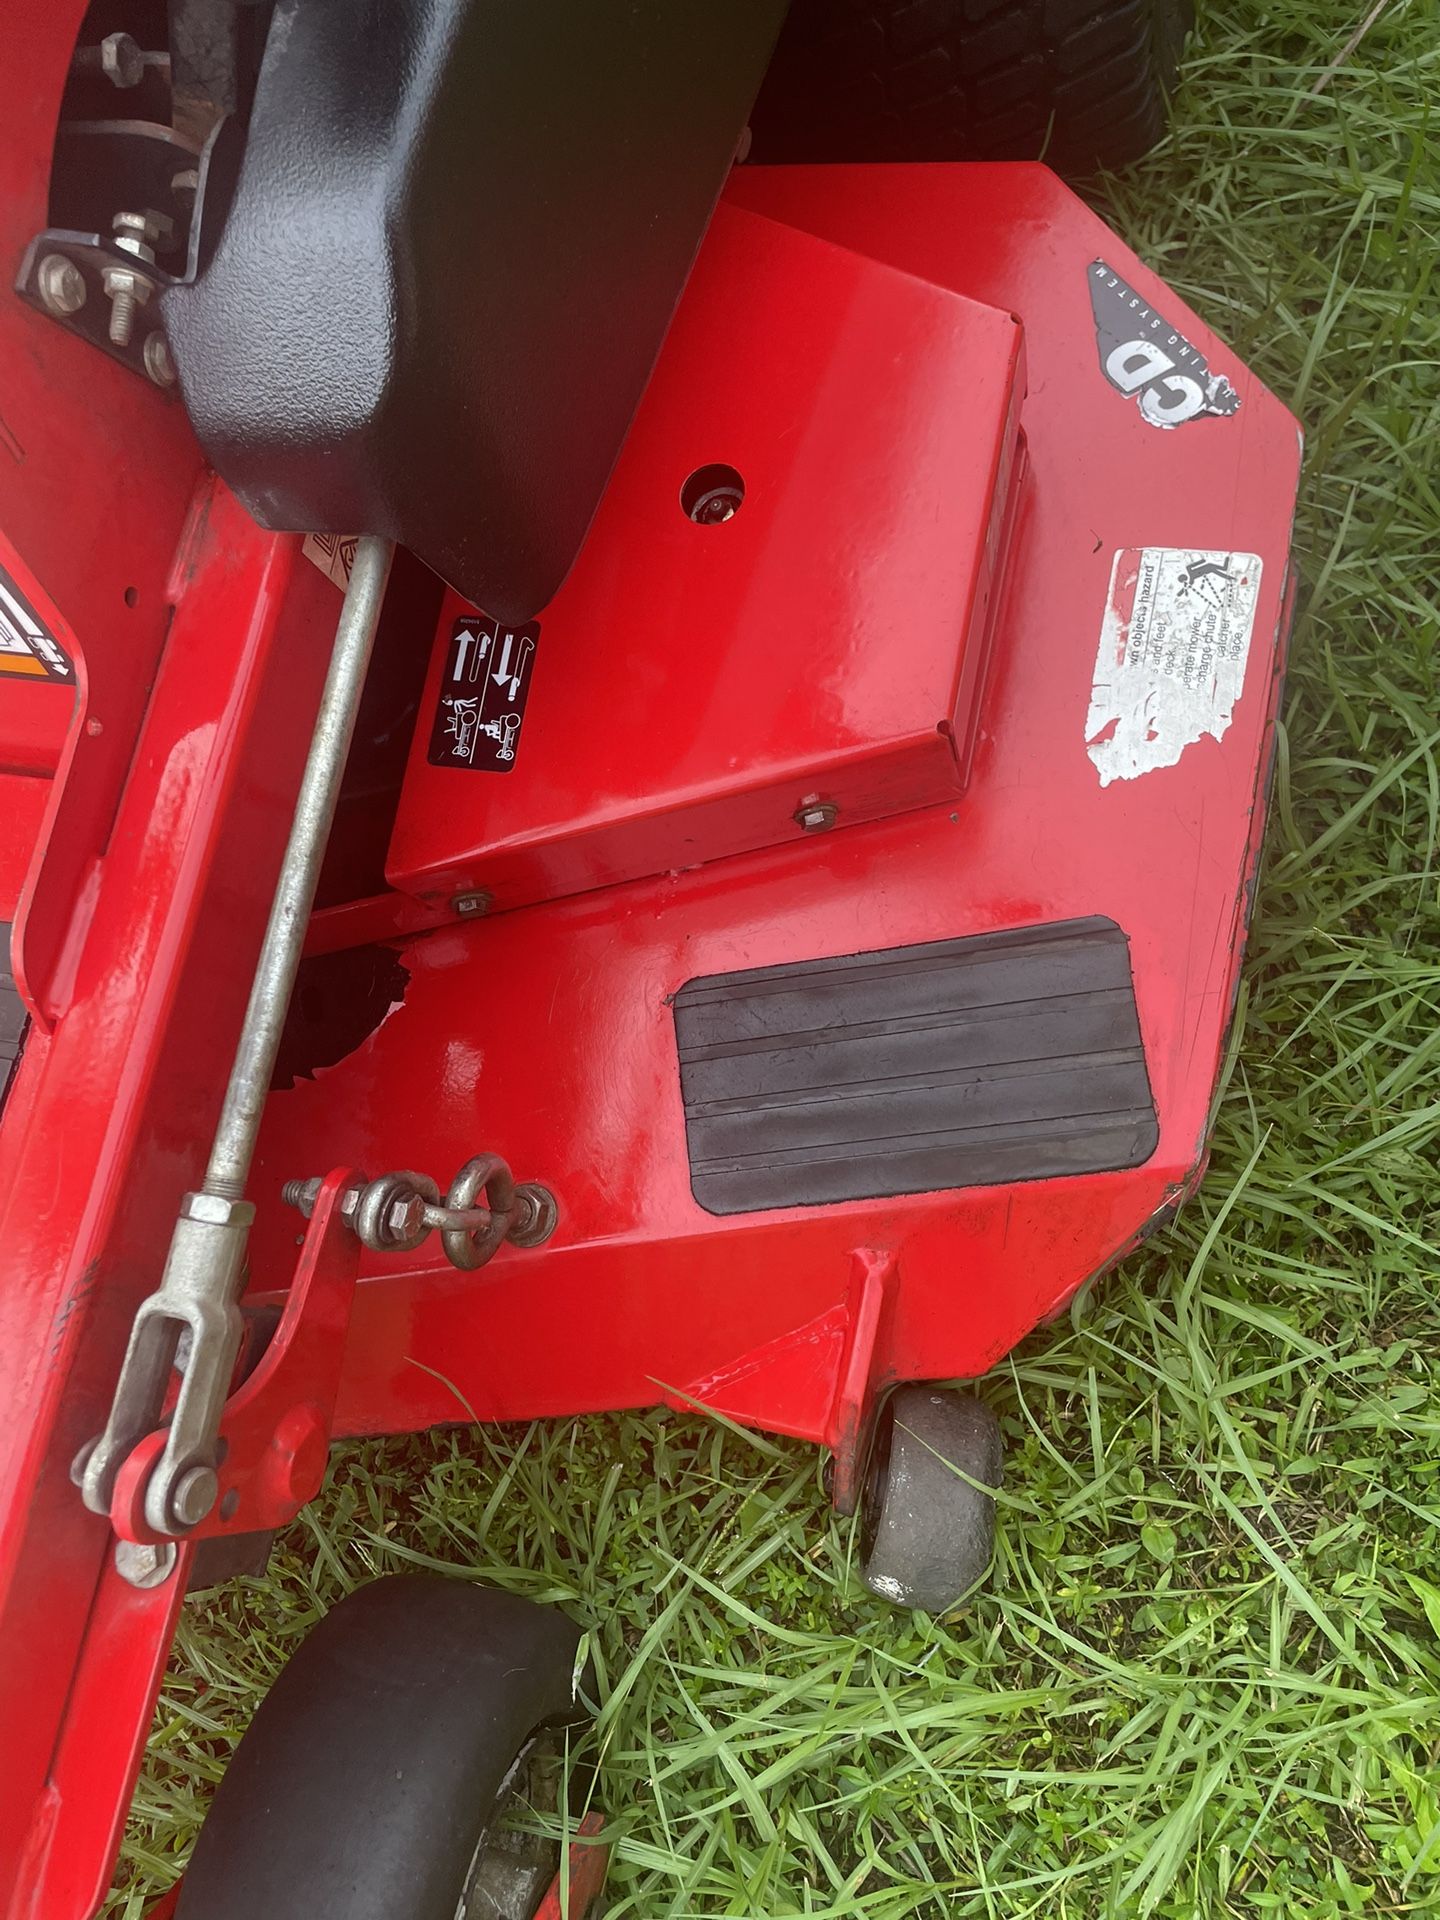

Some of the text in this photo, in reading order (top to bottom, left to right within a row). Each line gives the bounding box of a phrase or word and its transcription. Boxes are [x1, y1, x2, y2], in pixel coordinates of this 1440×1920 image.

[1095, 267, 1161, 329] SYSTEM
[1106, 340, 1204, 424] CD
[1138, 564, 1155, 603] hazard
[1156, 621, 1167, 643] feet
[1189, 616, 1202, 653] mower
[1205, 613, 1217, 644] chute
[1217, 618, 1231, 658] catcher
[1154, 643, 1165, 665] and
